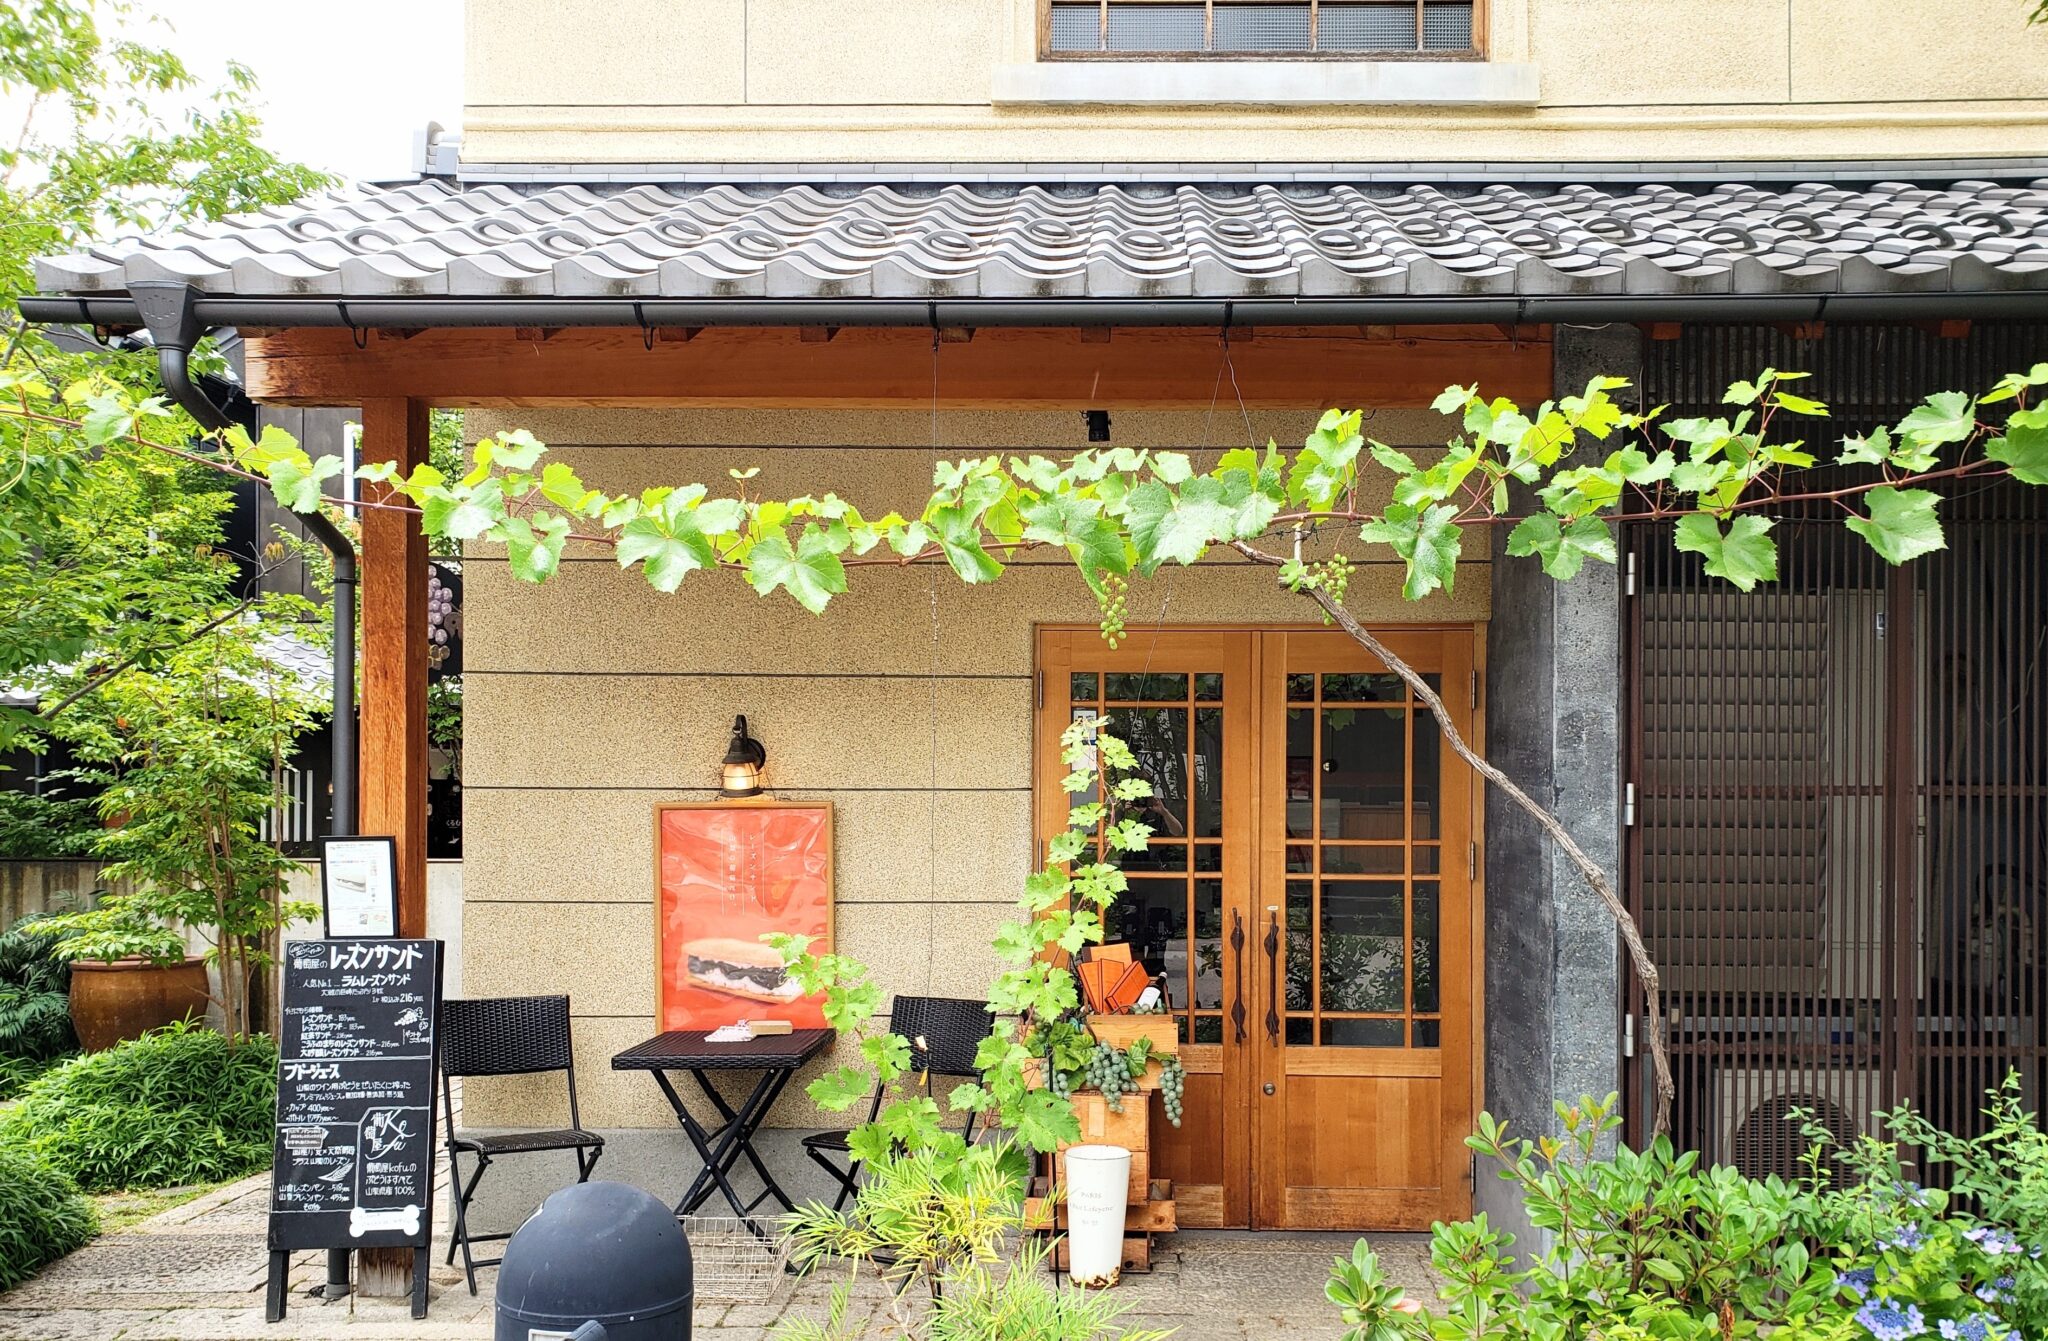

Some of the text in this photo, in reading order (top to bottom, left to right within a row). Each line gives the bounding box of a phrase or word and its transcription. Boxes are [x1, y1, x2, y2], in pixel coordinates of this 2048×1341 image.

[330, 943, 423, 970] レーズンサンド
[341, 973, 411, 987] ラムレーズンサンド
[365, 1174, 414, 1185] ぶどうはすべて
[394, 1186, 416, 1196] 100%
